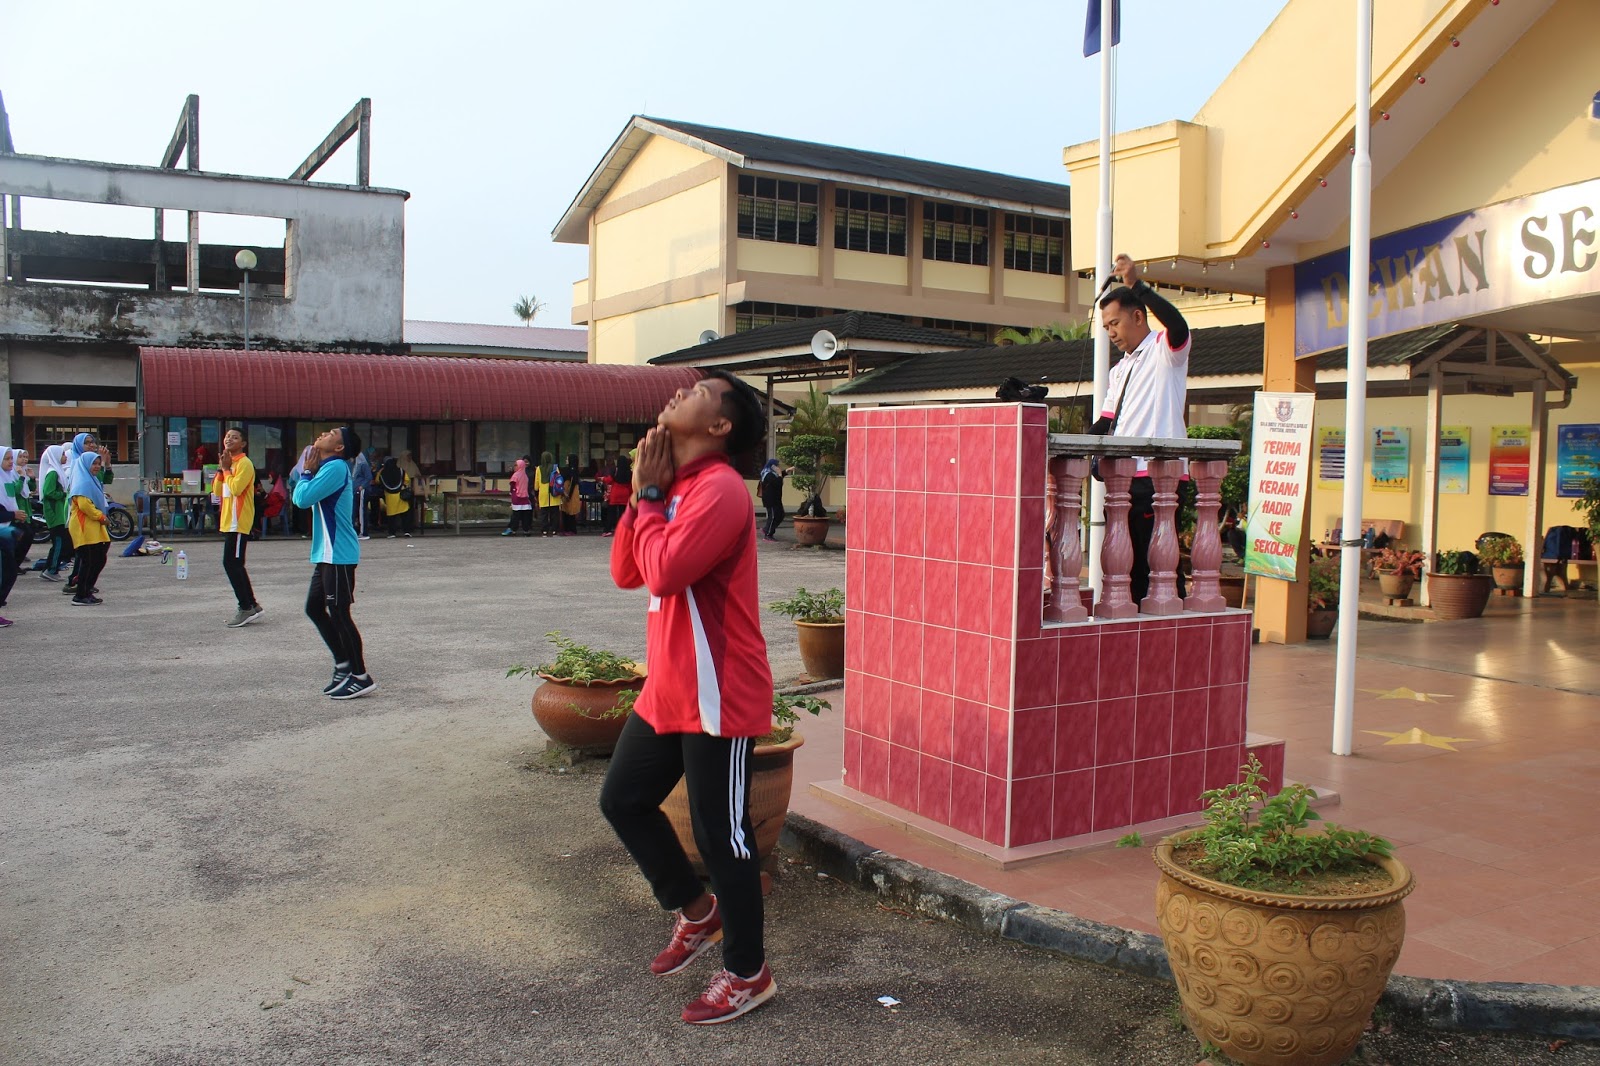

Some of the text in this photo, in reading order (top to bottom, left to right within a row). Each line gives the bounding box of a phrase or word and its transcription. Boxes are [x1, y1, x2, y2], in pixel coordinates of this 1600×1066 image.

[1263, 440, 1300, 456] TERIMA
[1265, 461, 1295, 476] KASIH
[1259, 481, 1299, 497] KERANA
[1262, 500, 1291, 516] HADIR
[1269, 521, 1282, 536] KE
[1254, 539, 1295, 557] SEKOLAH
